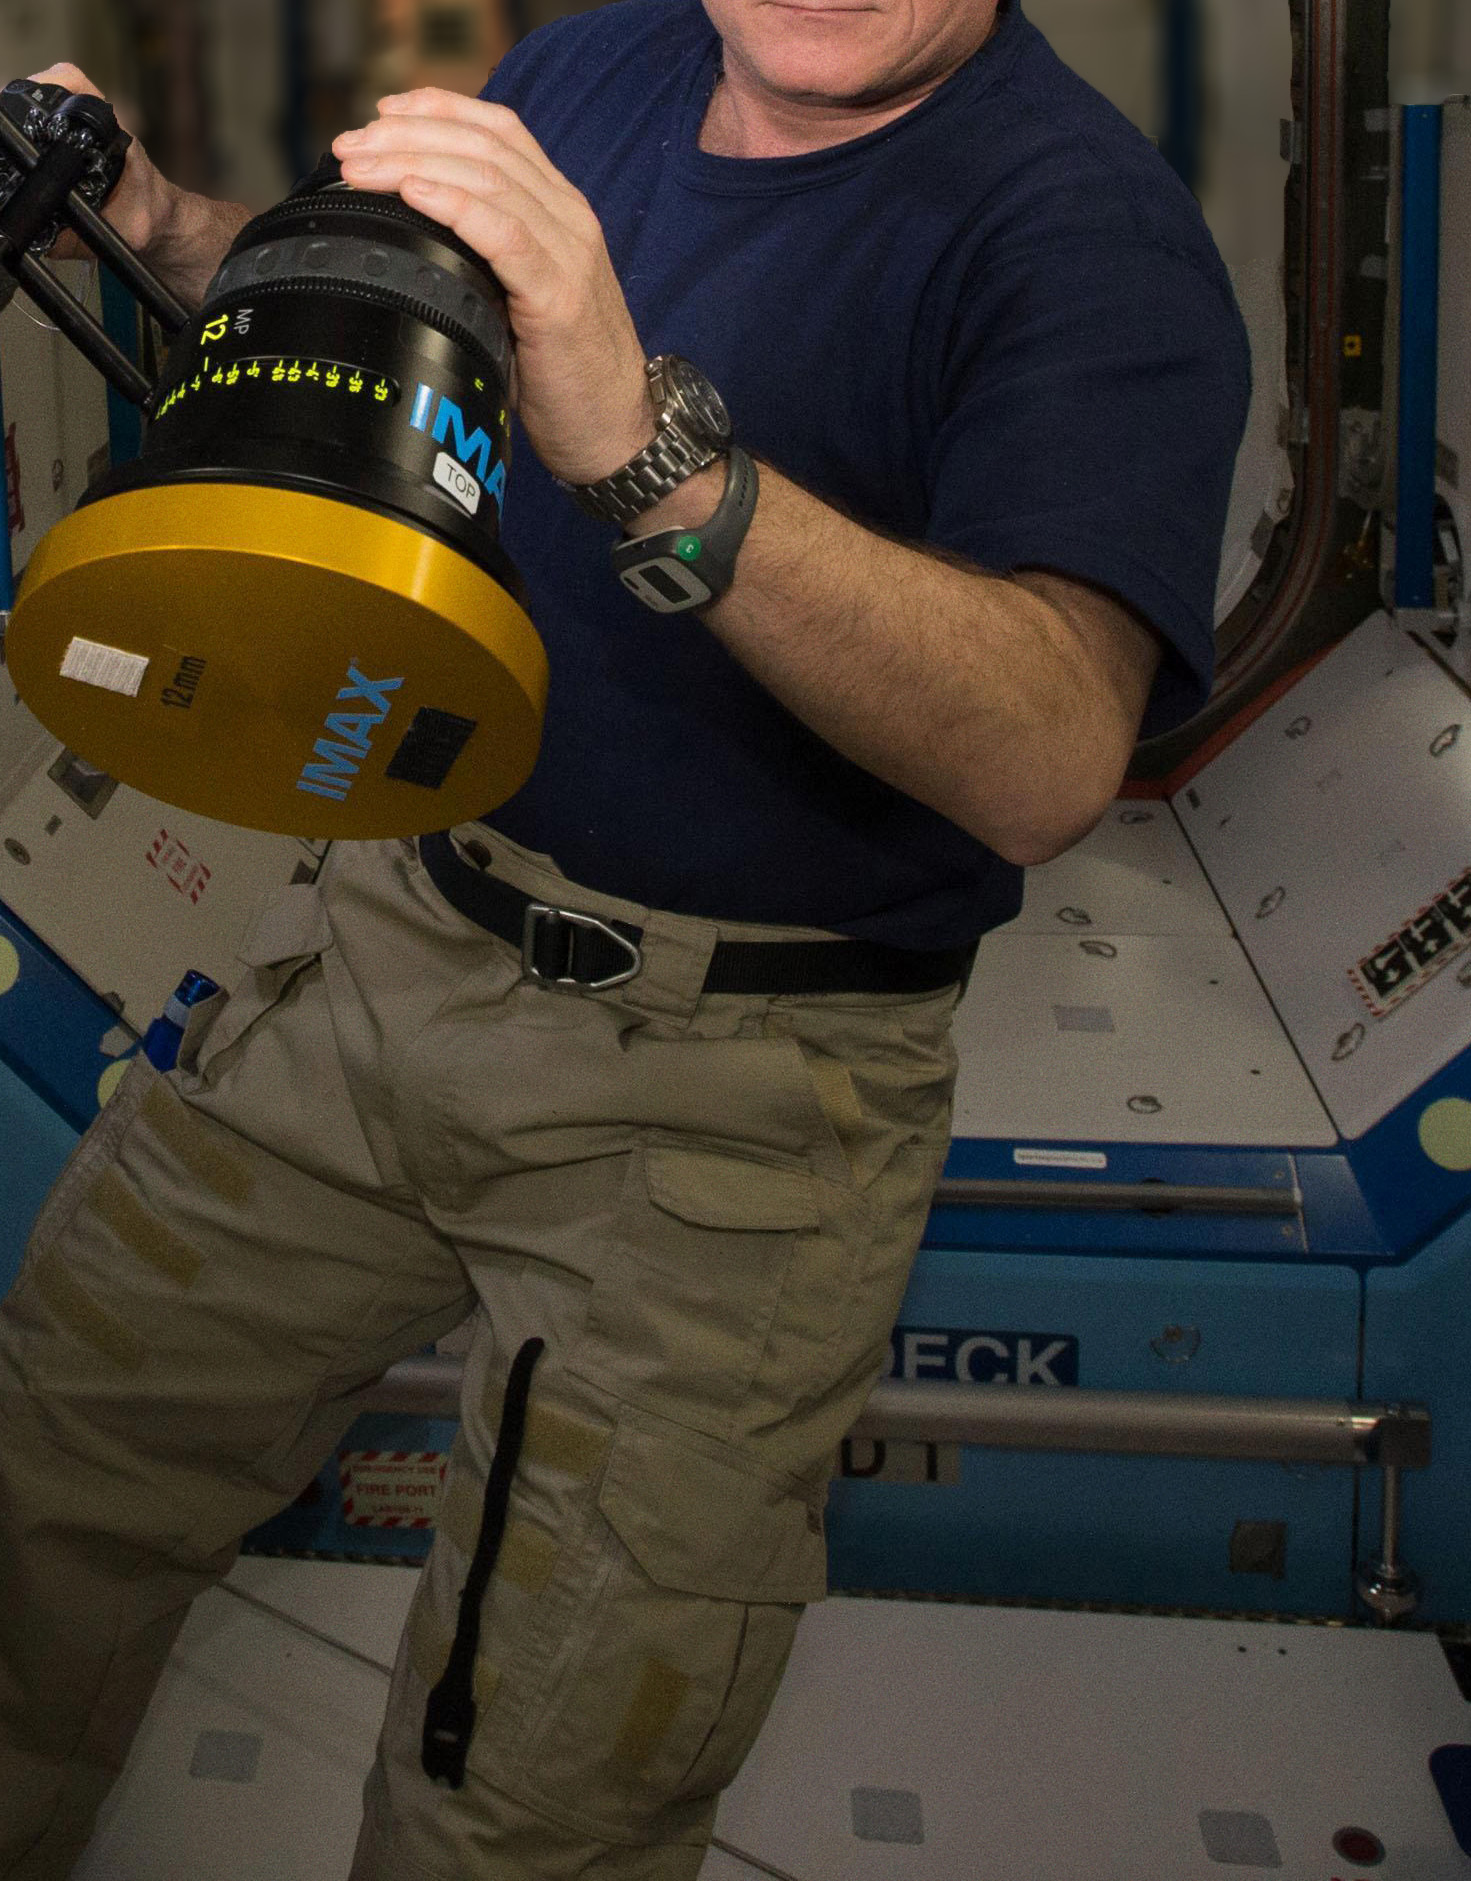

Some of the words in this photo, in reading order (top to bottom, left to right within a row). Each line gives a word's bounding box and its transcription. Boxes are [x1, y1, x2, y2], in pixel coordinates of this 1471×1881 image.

[201, 314, 228, 346] 12
[446, 463, 477, 499] TOP
[160, 655, 207, 710] 12mm
[296, 664, 405, 802] IMAX
